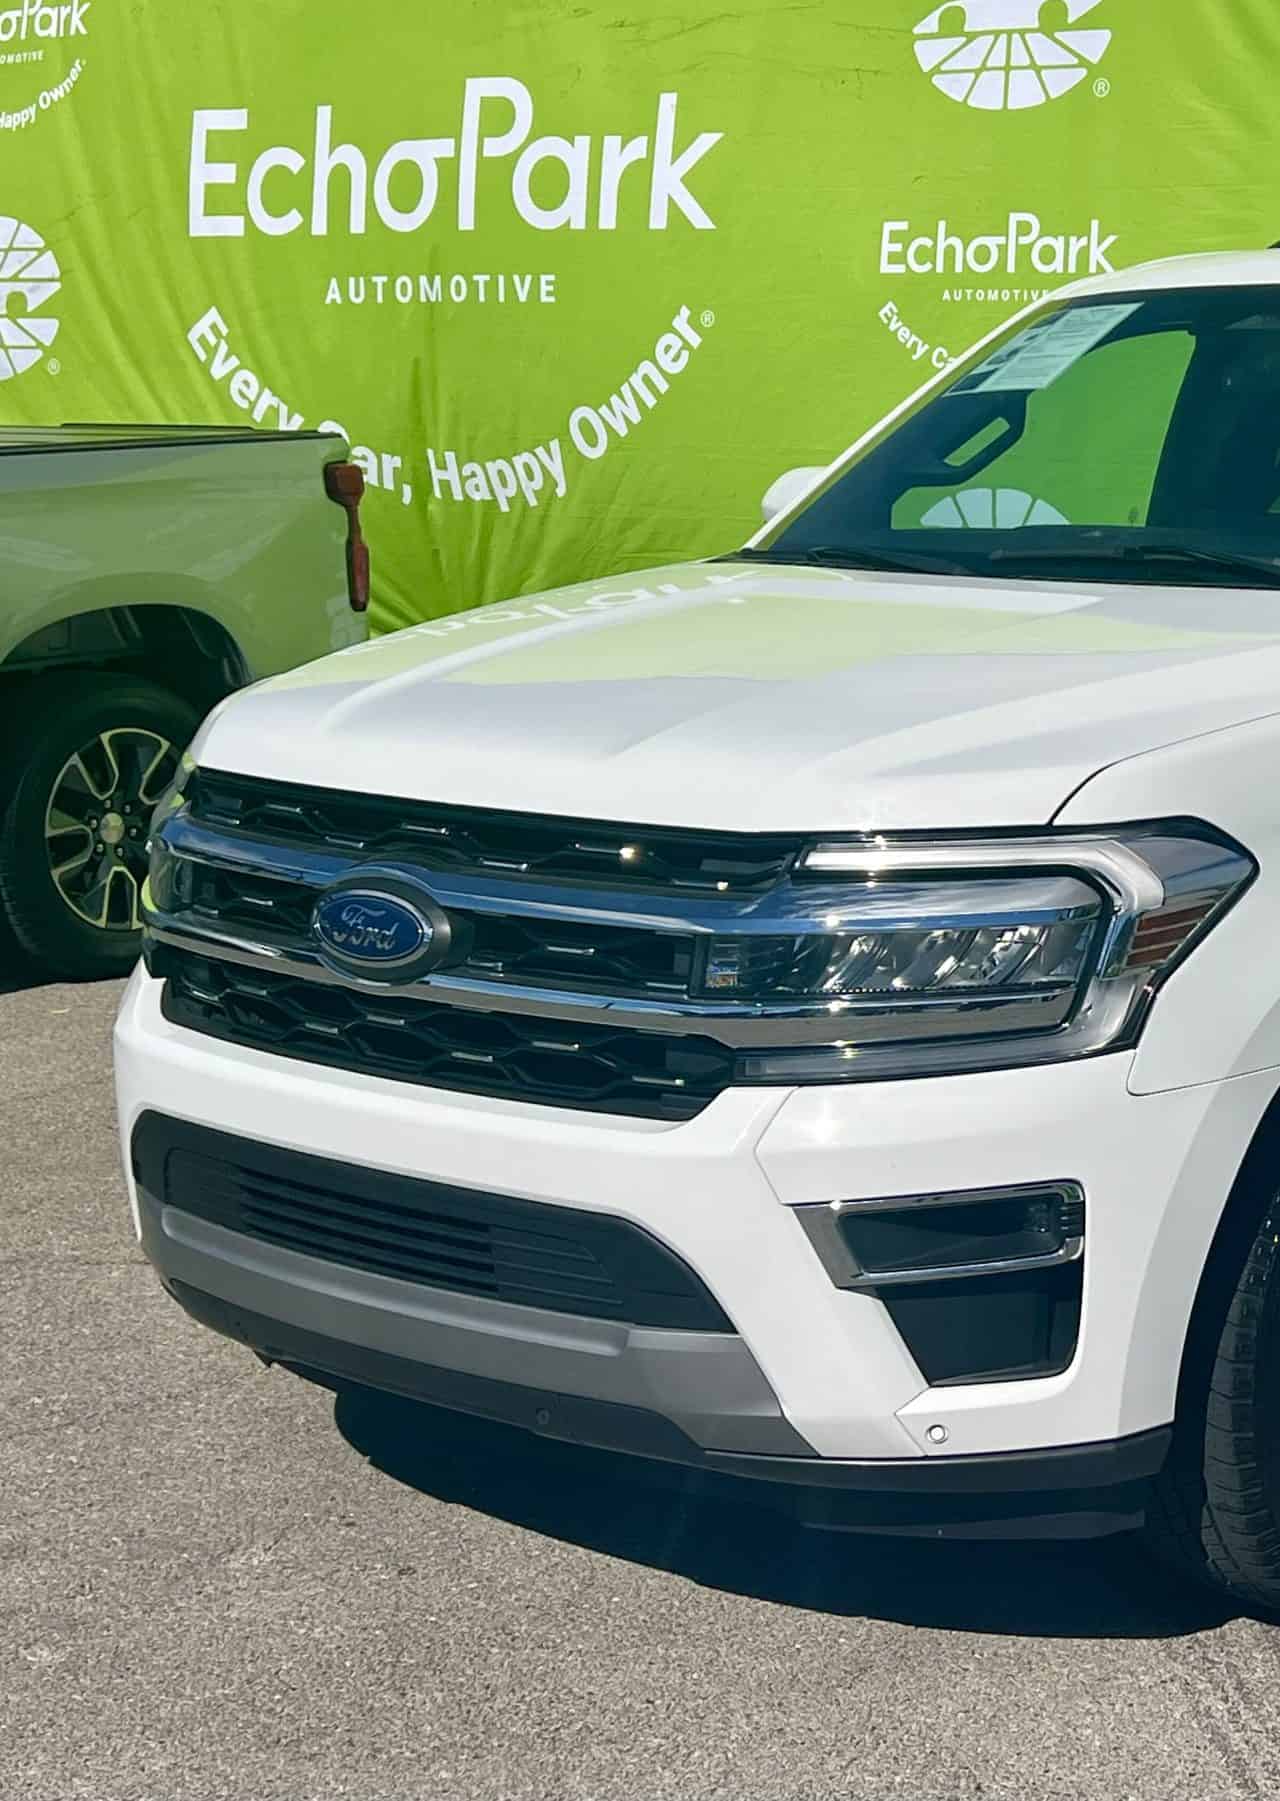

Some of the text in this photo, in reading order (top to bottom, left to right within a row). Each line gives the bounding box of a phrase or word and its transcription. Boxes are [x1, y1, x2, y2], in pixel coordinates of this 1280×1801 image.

[188, 76, 725, 237] EchoPark
[880, 212, 1119, 274] EchoPark
[325, 274, 557, 304] AUTOMOTIVE
[879, 301, 929, 361] Every
[427, 448, 567, 512] Happy
[332, 904, 400, 950] Ford
